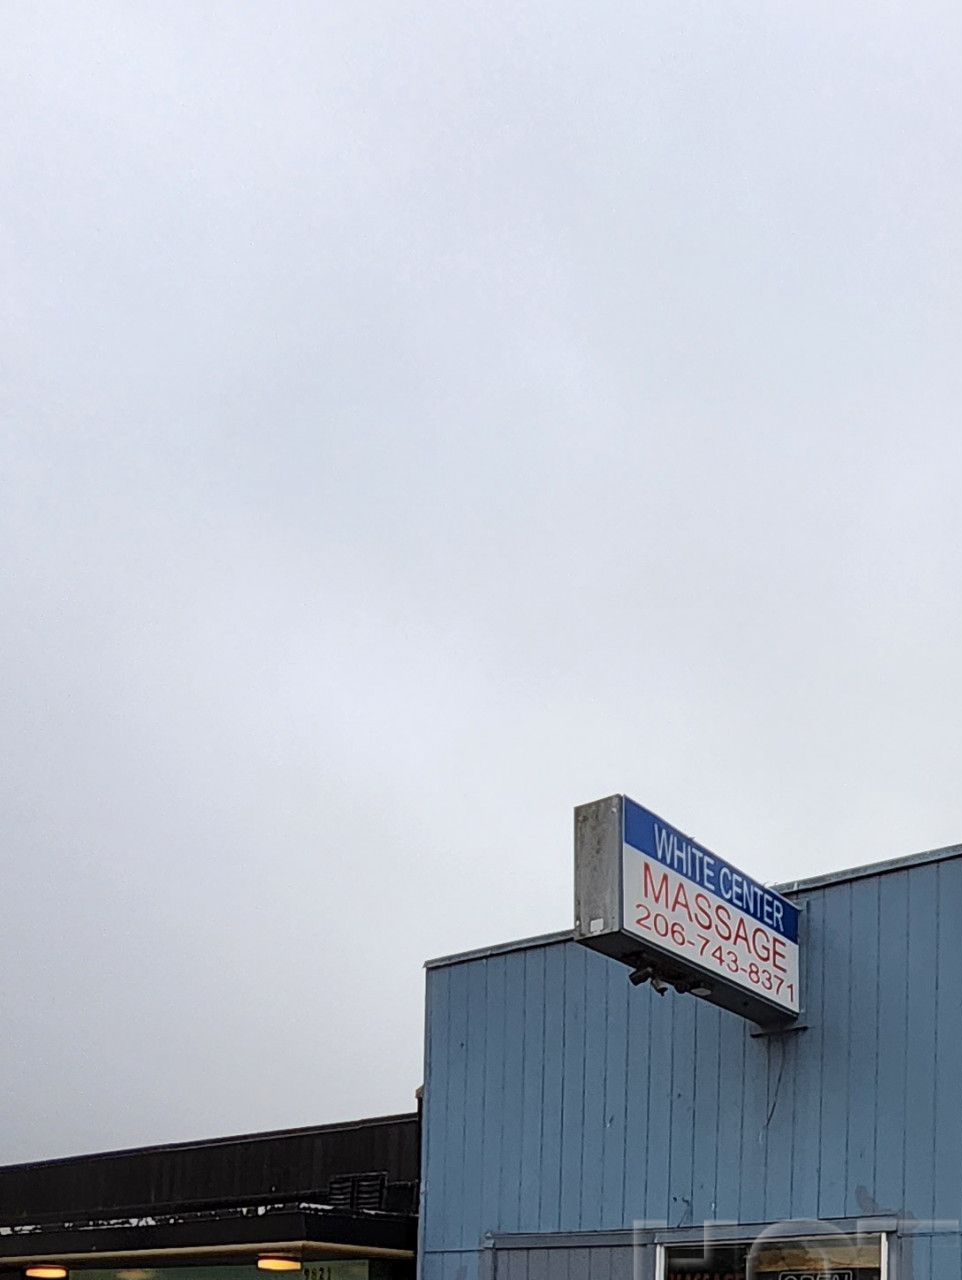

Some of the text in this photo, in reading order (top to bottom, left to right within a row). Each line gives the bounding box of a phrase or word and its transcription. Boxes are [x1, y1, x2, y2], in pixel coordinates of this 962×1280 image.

[643, 861, 788, 974] MASSAGE
[654, 822, 785, 933] WHITE CENTER
[635, 903, 795, 1003] 206-743-8371
